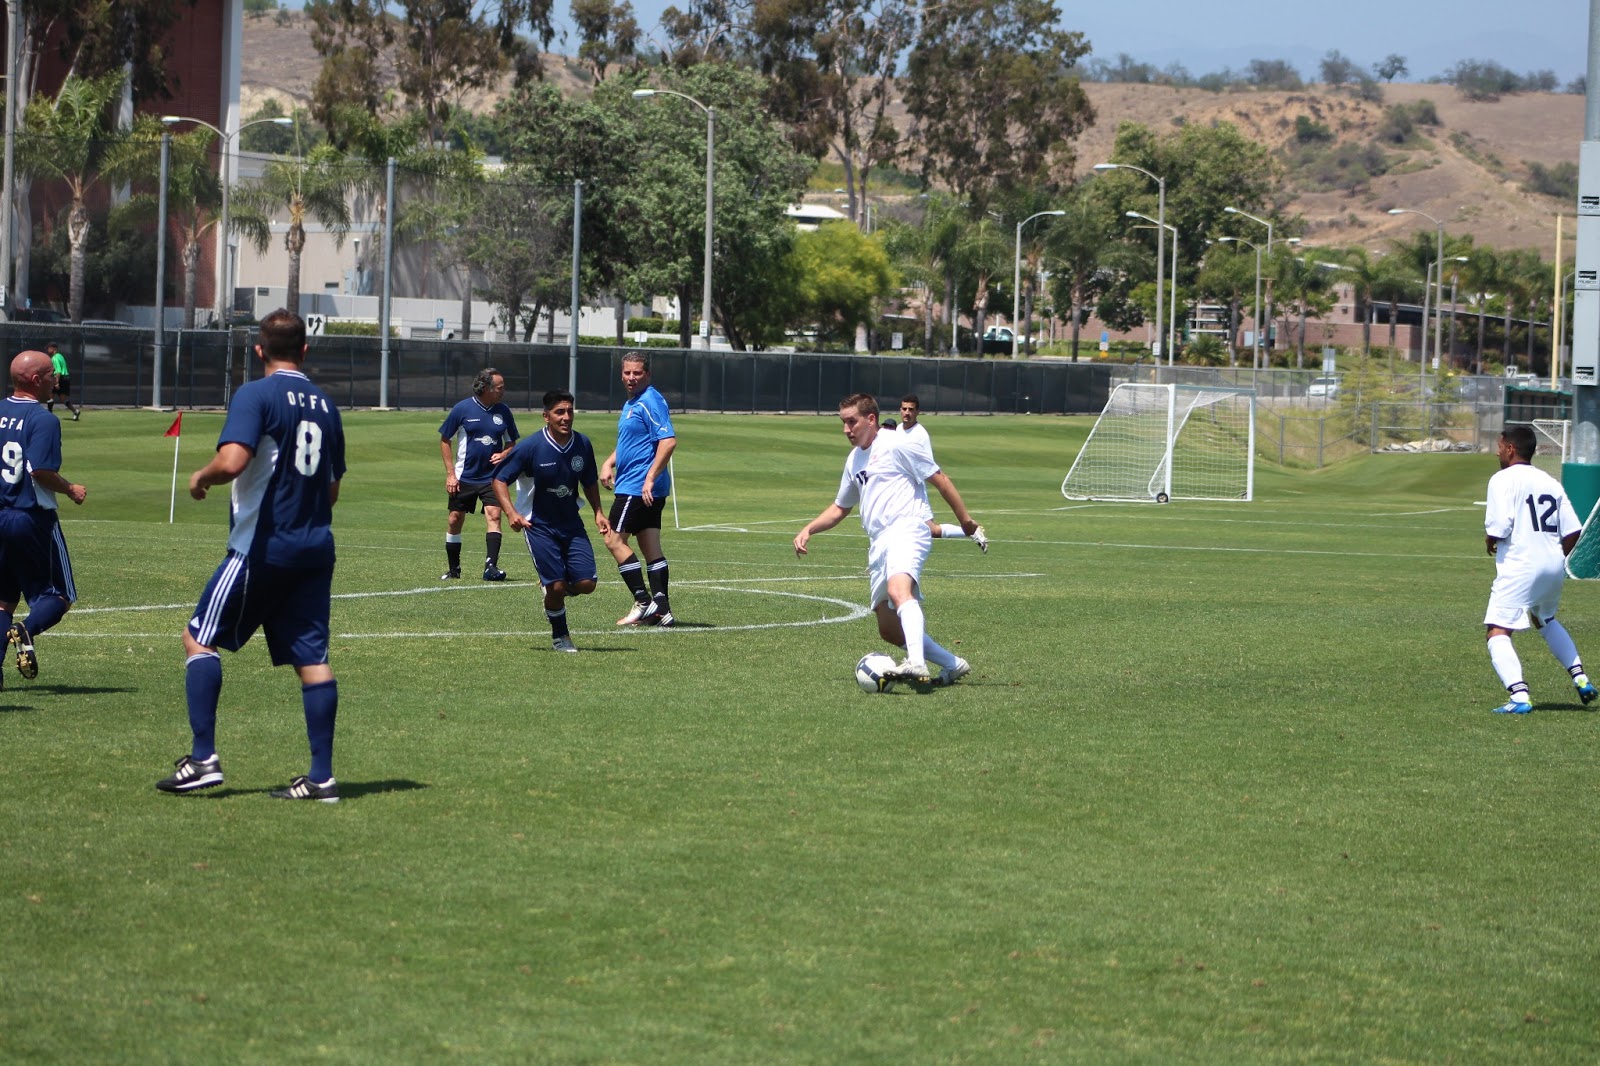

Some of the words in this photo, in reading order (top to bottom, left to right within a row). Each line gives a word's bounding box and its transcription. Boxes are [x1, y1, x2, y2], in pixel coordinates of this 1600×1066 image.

[287, 391, 329, 413] OCFA
[1, 441, 24, 485] 9
[295, 420, 323, 477] 8
[1525, 493, 1558, 533] 12
